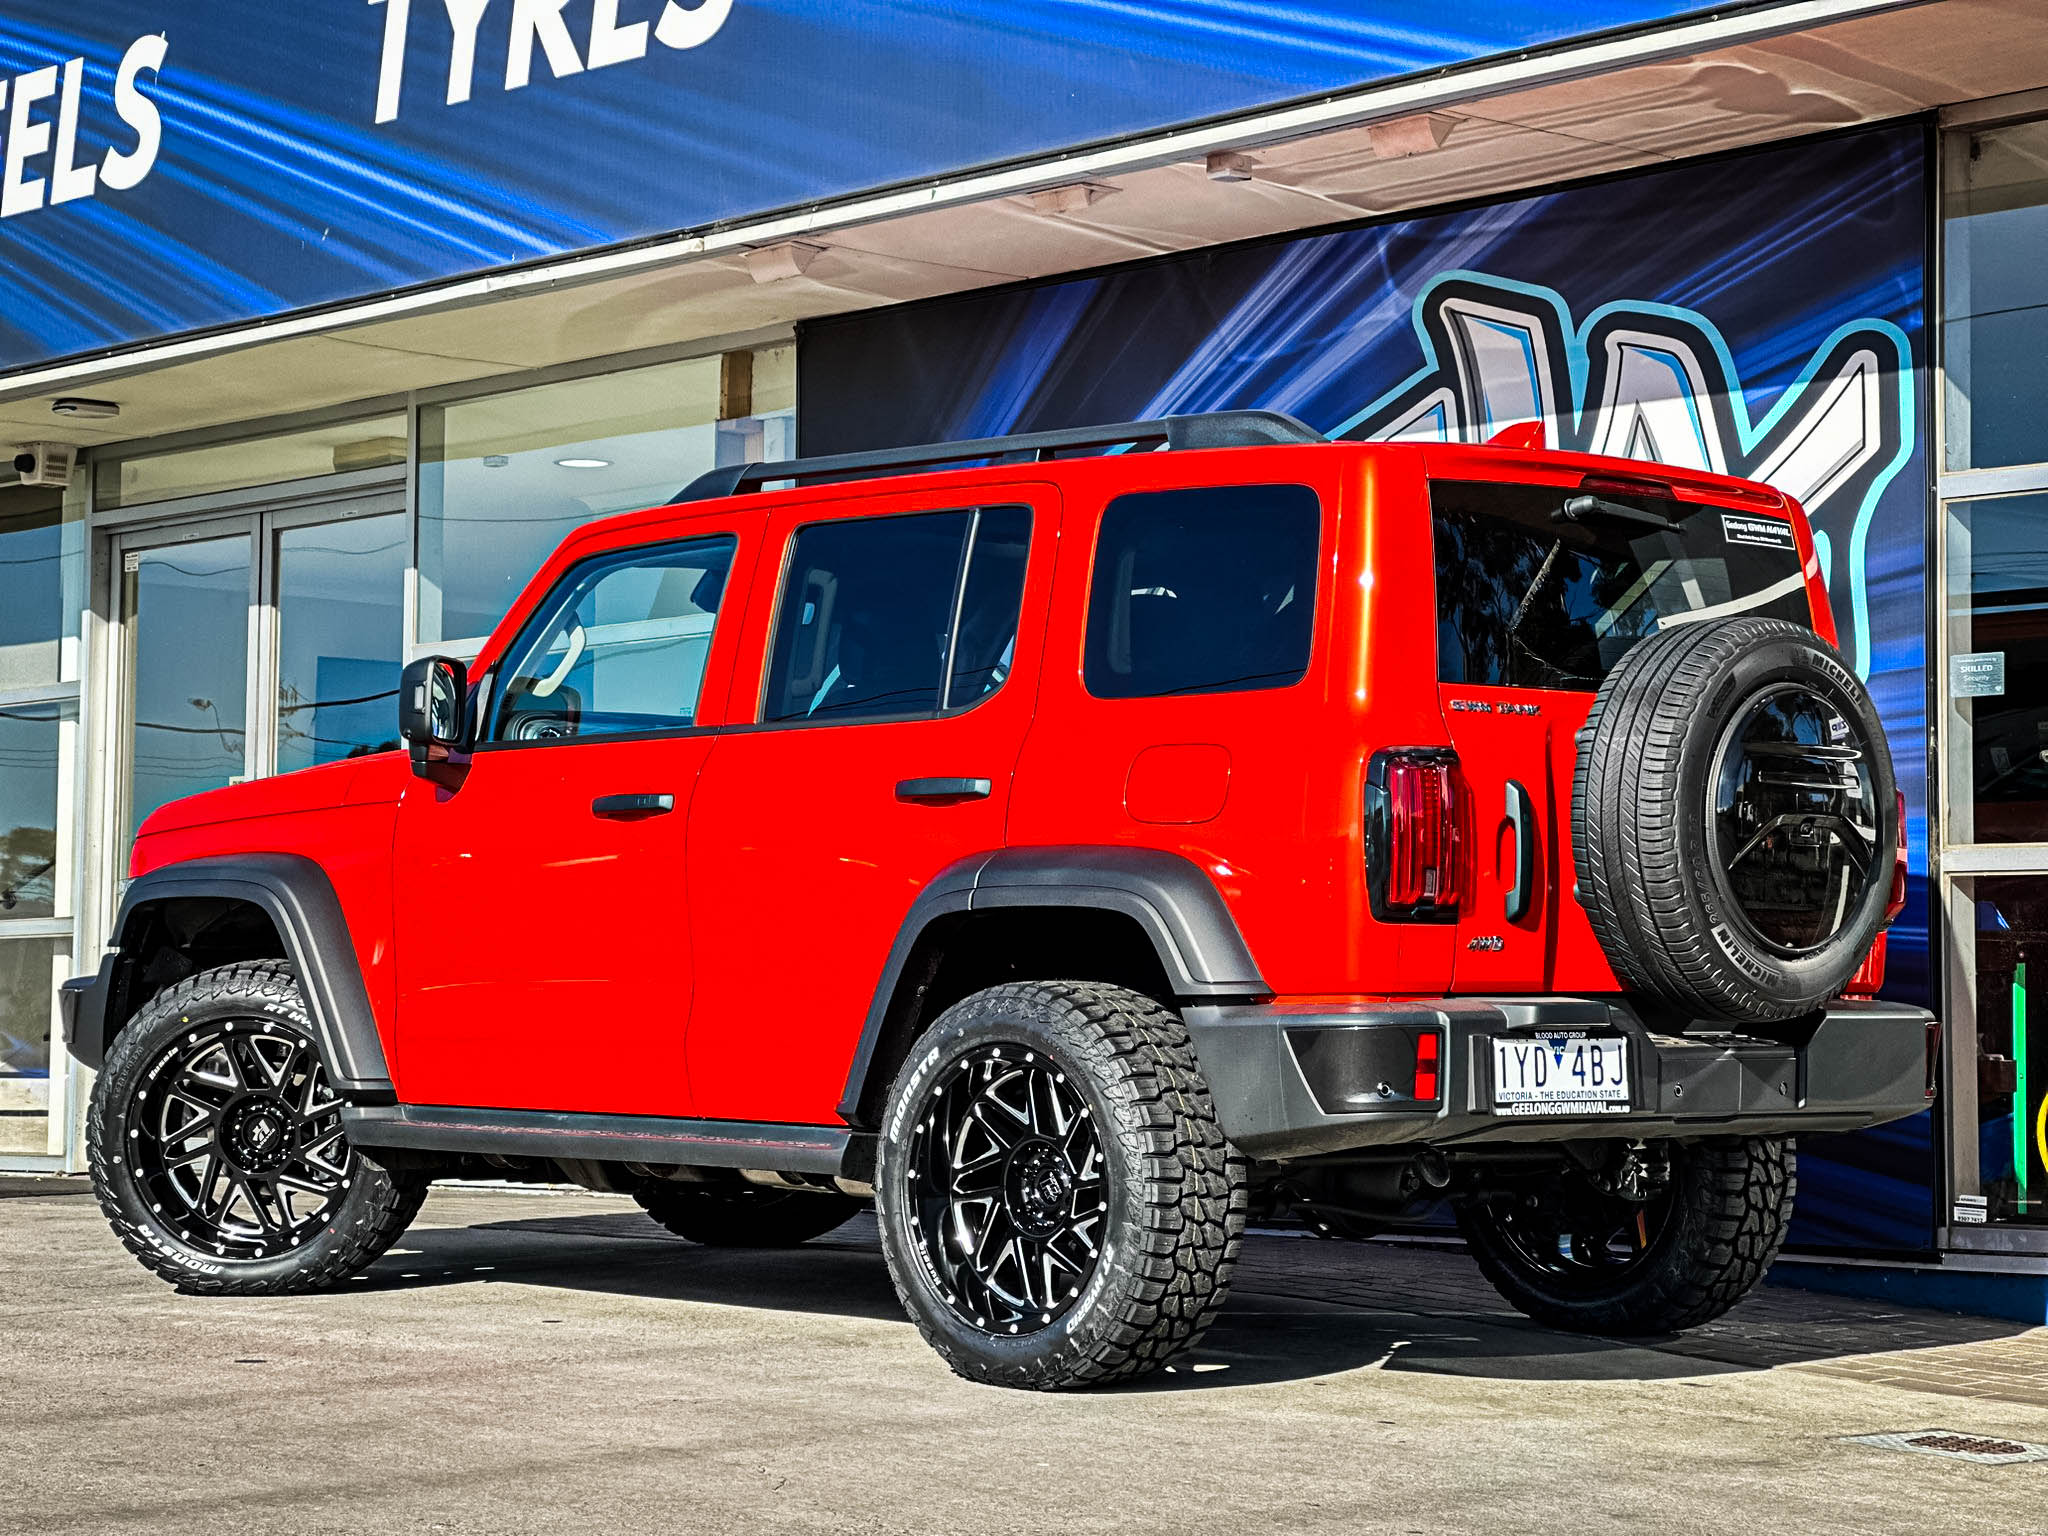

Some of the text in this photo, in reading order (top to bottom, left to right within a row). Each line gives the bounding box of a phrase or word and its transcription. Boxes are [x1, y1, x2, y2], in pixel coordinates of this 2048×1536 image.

[0, 33, 169, 218] ELS
[1960, 664, 1993, 673] SKILLED
[1717, 927, 1779, 988] MICHELIN
[1535, 1032, 1553, 1040] BLOOD
[1500, 1046, 1547, 1089] 1YD
[1572, 1045, 1623, 1087] 4BJ
[1498, 1091, 1533, 1101] VICTORIA
[1540, 1091, 1554, 1100] THE
[1556, 1090, 1598, 1100] EDUCATION
[1599, 1089, 1621, 1099] STATE
